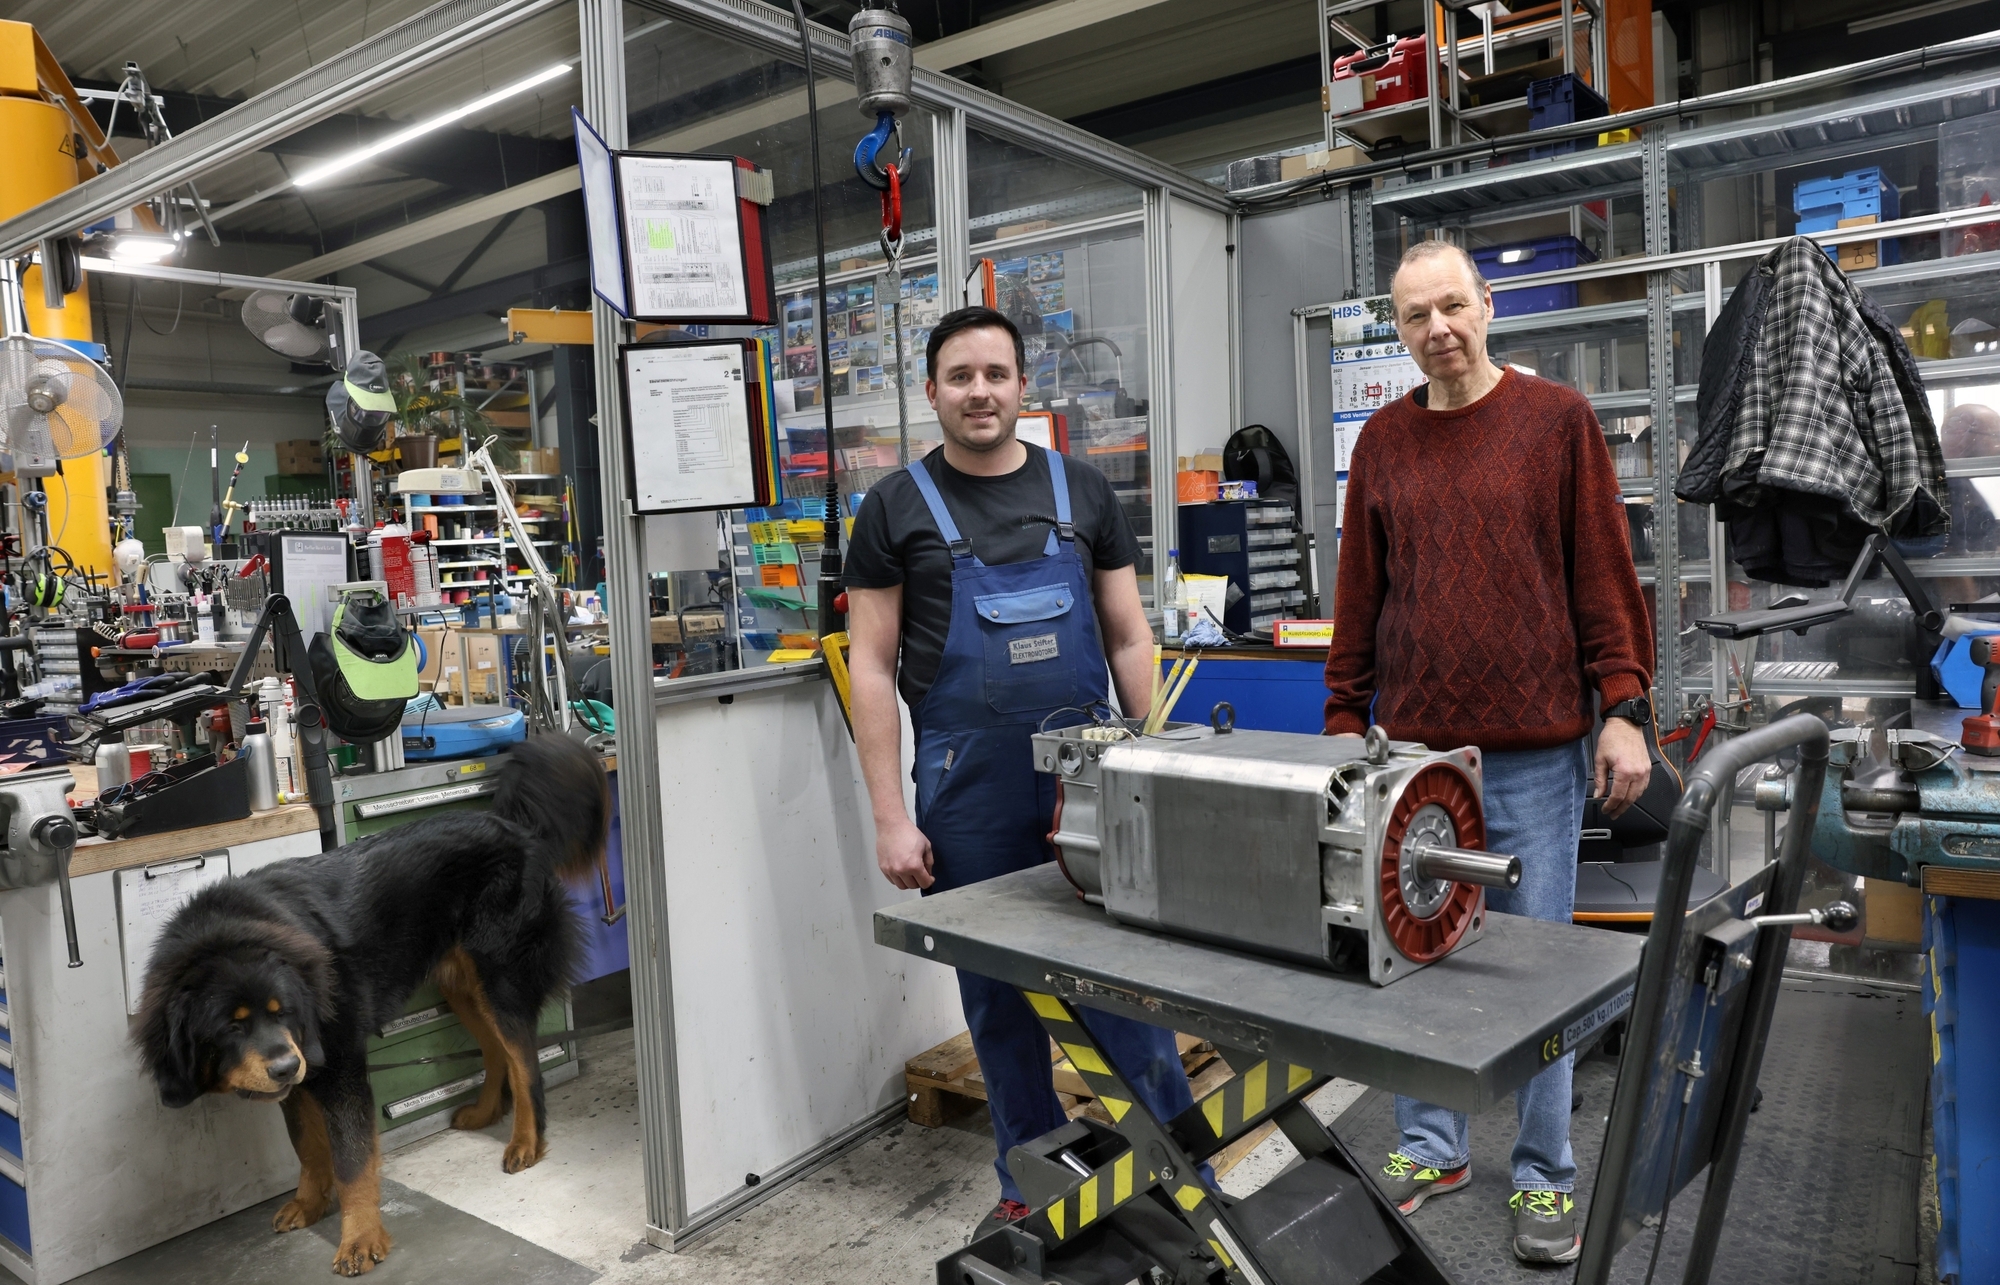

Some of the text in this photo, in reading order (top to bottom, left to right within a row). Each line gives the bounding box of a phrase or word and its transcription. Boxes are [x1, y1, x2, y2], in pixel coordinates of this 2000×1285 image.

[1333, 305, 1361, 319] HDS
[723, 370, 730, 378] 2
[1013, 639, 1053, 650] Klaus Stifter
[1012, 647, 1056, 660] ELEKTROMOTOREN
[1567, 1014, 1595, 1042] Cap.500
[1543, 1034, 1558, 1061] CE
